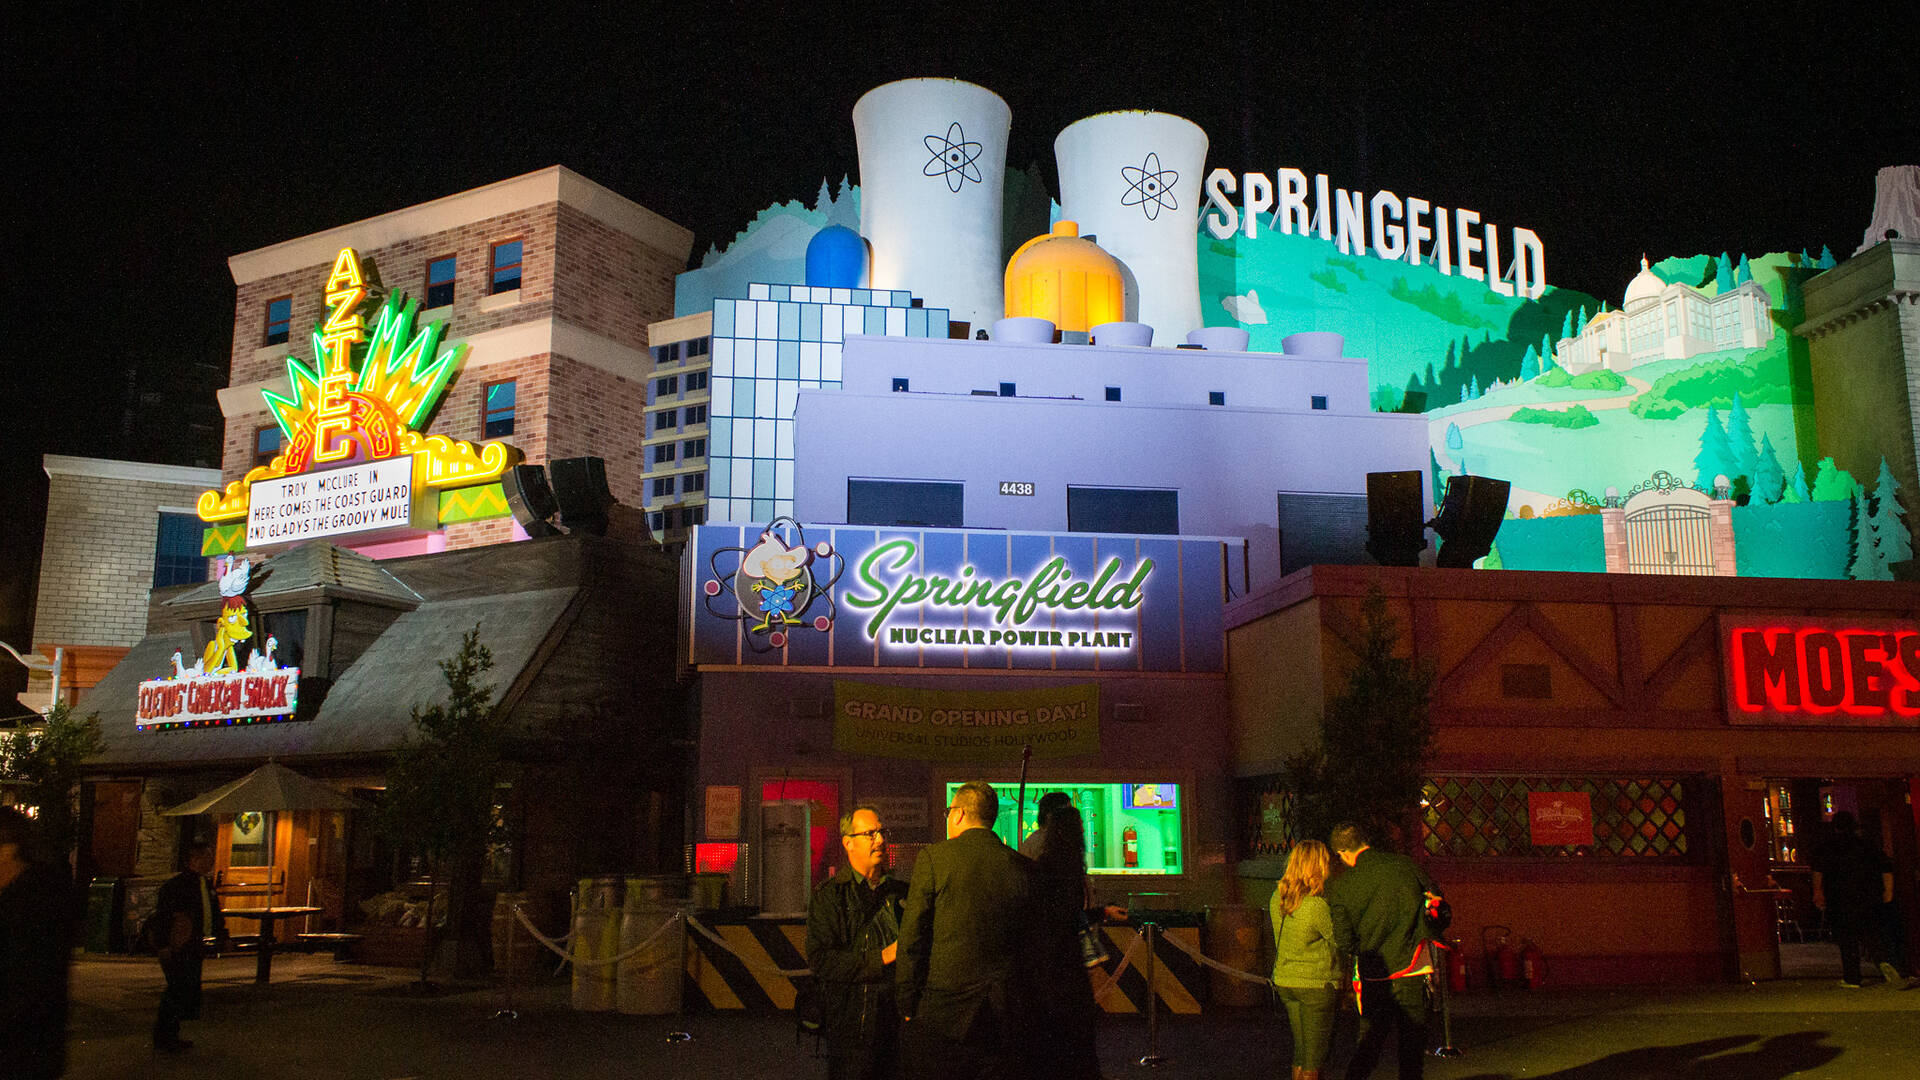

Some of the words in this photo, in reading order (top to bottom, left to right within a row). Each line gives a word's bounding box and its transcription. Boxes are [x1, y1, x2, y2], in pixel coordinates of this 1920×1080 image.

[1205, 167, 1545, 300] SPRINGFIELD
[314, 247, 367, 464] AZTEC
[254, 505, 275, 521] HERE
[279, 499, 312, 518] COMES
[315, 496, 331, 513] THE
[334, 491, 367, 509] COAST
[370, 484, 408, 503] GUARD
[282, 482, 307, 498] TROY
[318, 473, 359, 493] MCCLURE
[369, 470, 379, 484] IN
[1001, 482, 1032, 495] 4438
[249, 526, 265, 541] AND
[269, 519, 310, 538] GLADYS
[313, 515, 329, 531] THE
[332, 508, 378, 529] GROOVY
[381, 503, 409, 521] MULE
[846, 540, 1155, 639] Springfield
[890, 627, 985, 646] NUCLEAR
[989, 629, 1063, 647] POWER
[1068, 631, 1133, 649] PLANT
[187, 679, 243, 714] CHICKEN
[243, 675, 290, 710] SHACK
[844, 700, 924, 724] GRAND
[930, 709, 1029, 727] OPENING
[1036, 701, 1088, 723] DAY!
[855, 729, 929, 745] UNIVERSAL
[934, 735, 991, 747] STUDIOS
[995, 728, 1078, 747] HOLLYWOOD
